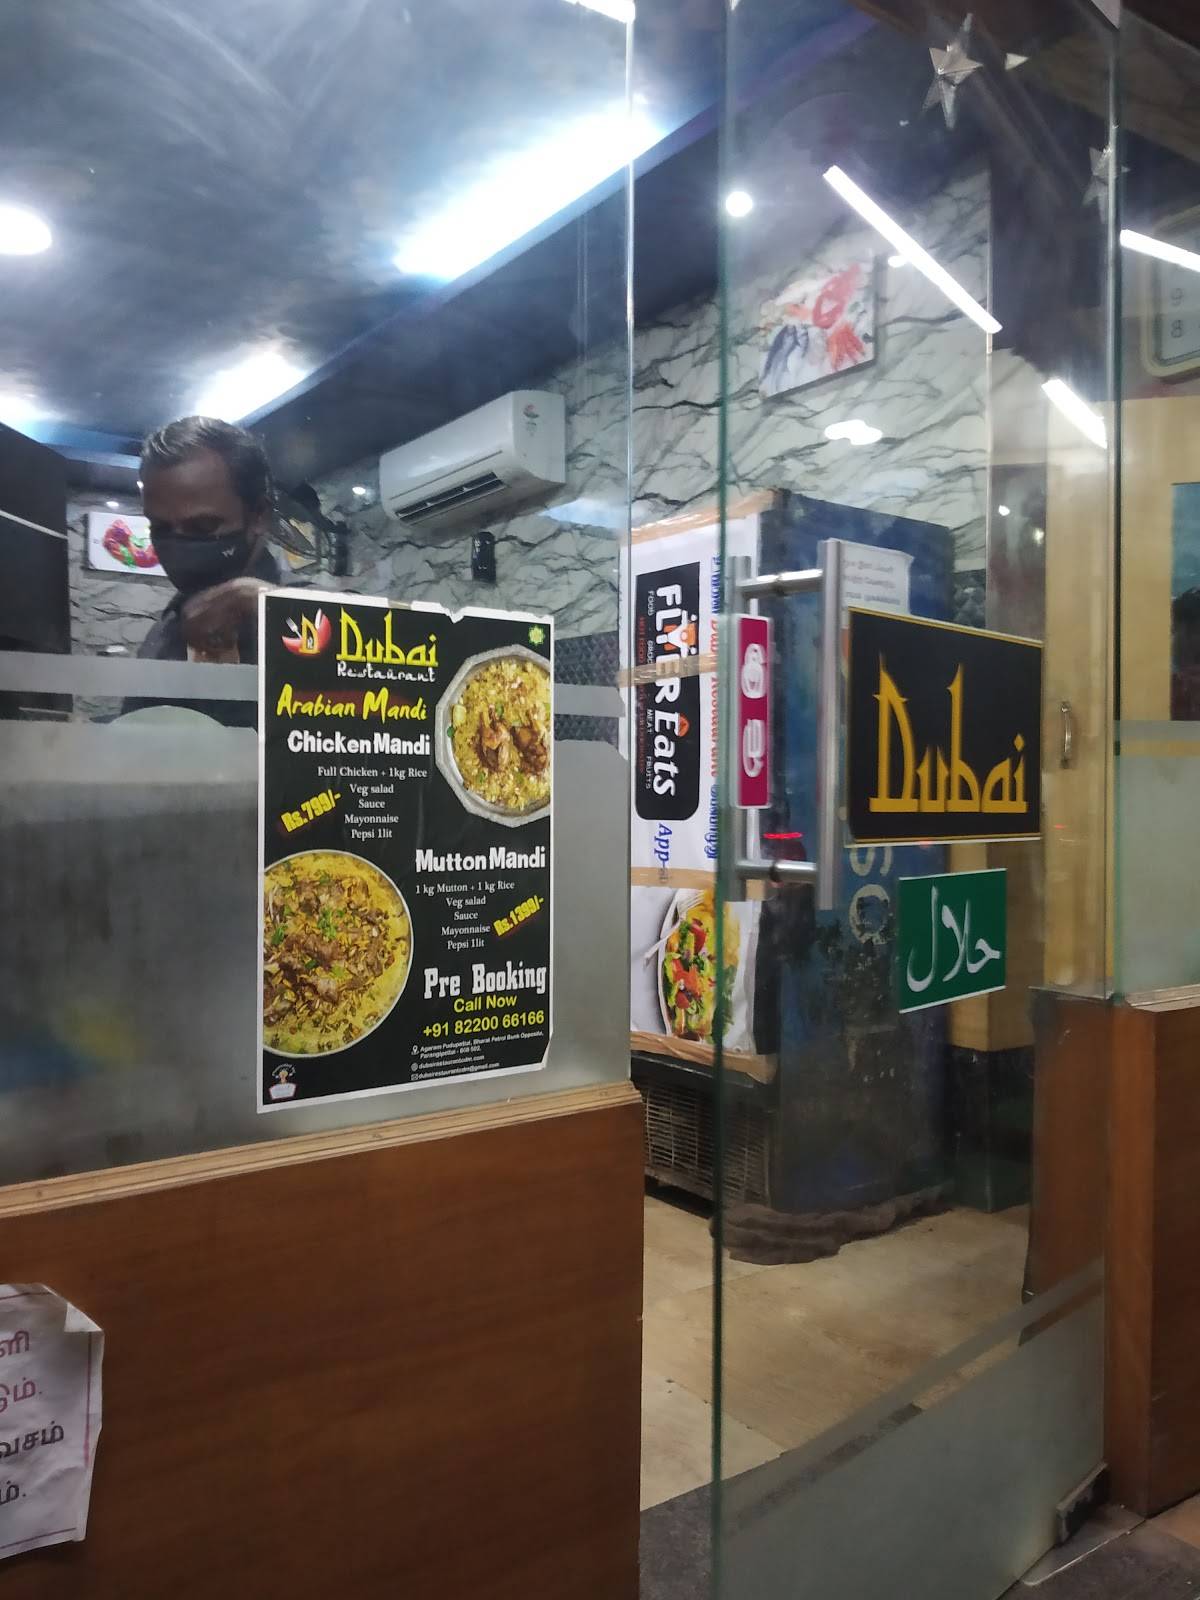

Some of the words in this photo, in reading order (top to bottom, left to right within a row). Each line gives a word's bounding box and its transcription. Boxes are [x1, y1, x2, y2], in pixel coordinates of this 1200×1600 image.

[647, 590, 655, 616] FOOD
[336, 607, 439, 668] Dubai
[336, 660, 436, 683] Restaurant
[276, 684, 356, 719] Arabian
[362, 687, 427, 724] Mandi
[646, 709, 654, 733] MEAT
[869, 652, 1028, 814] Dubai
[287, 730, 371, 755] Chicken
[373, 731, 430, 756] Mandi
[653, 710, 680, 797] Eats
[318, 766, 337, 777] Full
[339, 766, 378, 777] Chicken
[389, 767, 405, 781] 1kg
[408, 767, 427, 778] Rice
[645, 756, 653, 789] FRUITS
[350, 784, 368, 796] Veg
[371, 784, 394, 794] salad
[280, 789, 341, 833] Rs.799/-
[358, 799, 385, 809] Sauce
[344, 814, 399, 826] Mayonnaise
[351, 829, 375, 841] Pepsi
[416, 849, 487, 872] Mutton
[489, 846, 546, 869] Mandi
[423, 884, 435, 897] kg
[437, 883, 468, 893] Mutton
[484, 881, 496, 893] kg
[497, 880, 515, 890] Rice
[446, 897, 463, 909] Veg
[465, 895, 486, 906] salad
[454, 911, 478, 921] Sauce
[441, 924, 491, 938] Mayonnaise
[905, 884, 1001, 992] حلال
[447, 939, 469, 952] Pepsi
[424, 967, 460, 999] Pre
[472, 961, 547, 996] Booking
[454, 996, 482, 1014] Call
[486, 994, 518, 1011] Now
[423, 1021, 449, 1039] +91
[454, 1015, 498, 1035] 82200
[502, 1009, 545, 1029] 66166
